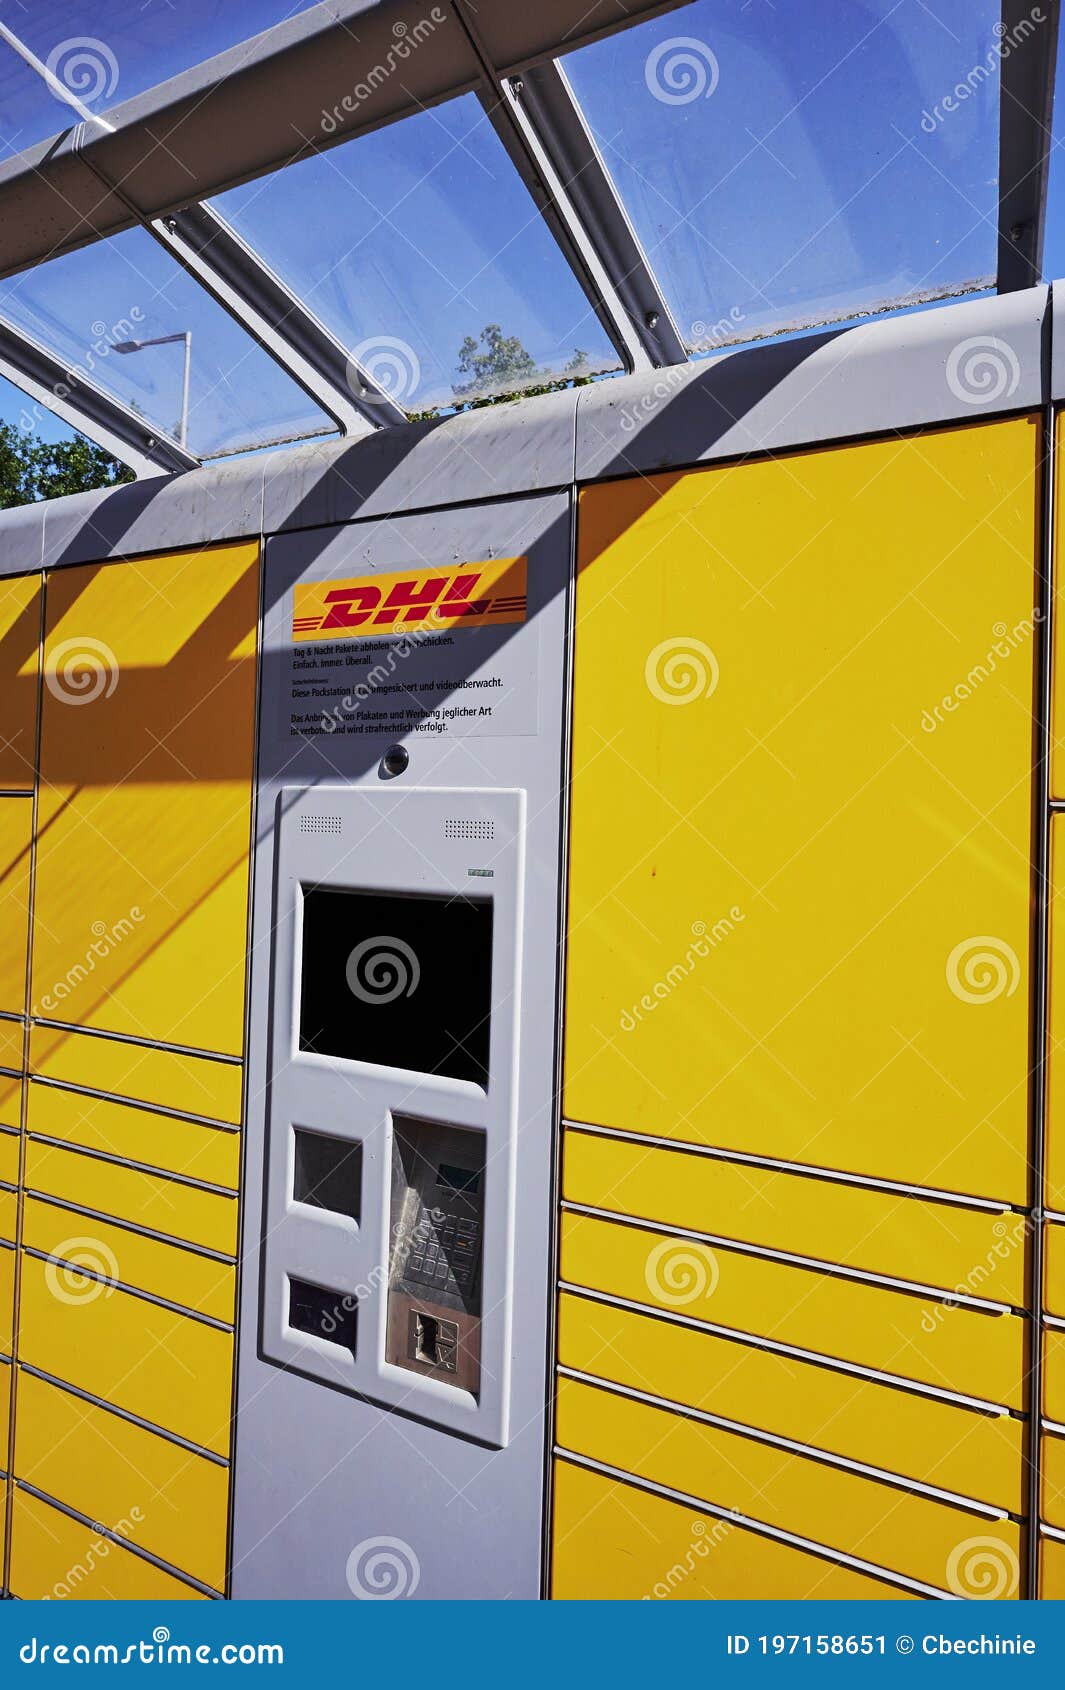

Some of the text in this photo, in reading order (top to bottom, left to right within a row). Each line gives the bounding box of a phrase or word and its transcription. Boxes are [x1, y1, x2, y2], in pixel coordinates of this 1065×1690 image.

[319, 573, 492, 630] DHL
[293, 648, 305, 658] Tag
[306, 648, 313, 656] &
[314, 646, 333, 656] Nacht
[335, 644, 359, 654] Pakete
[360, 641, 389, 652] abholen
[292, 660, 319, 670] Einfach.
[345, 655, 373, 667] Überall.
[292, 688, 310, 698] Diese
[311, 686, 351, 697] Packstation
[419, 681, 434, 691] und
[436, 677, 504, 690] videoüberwacht.
[291, 714, 303, 723] Das
[342, 712, 355, 721] von
[357, 711, 388, 720] Plakaten
[390, 709, 405, 719] und
[406, 709, 440, 720] Werbung
[441, 707, 477, 719] jeglicher
[478, 706, 492, 716] Art
[333, 725, 346, 735] und
[347, 723, 363, 733] wird
[364, 721, 413, 733] strafrechtlich
[415, 722, 448, 733] verfolgt.
